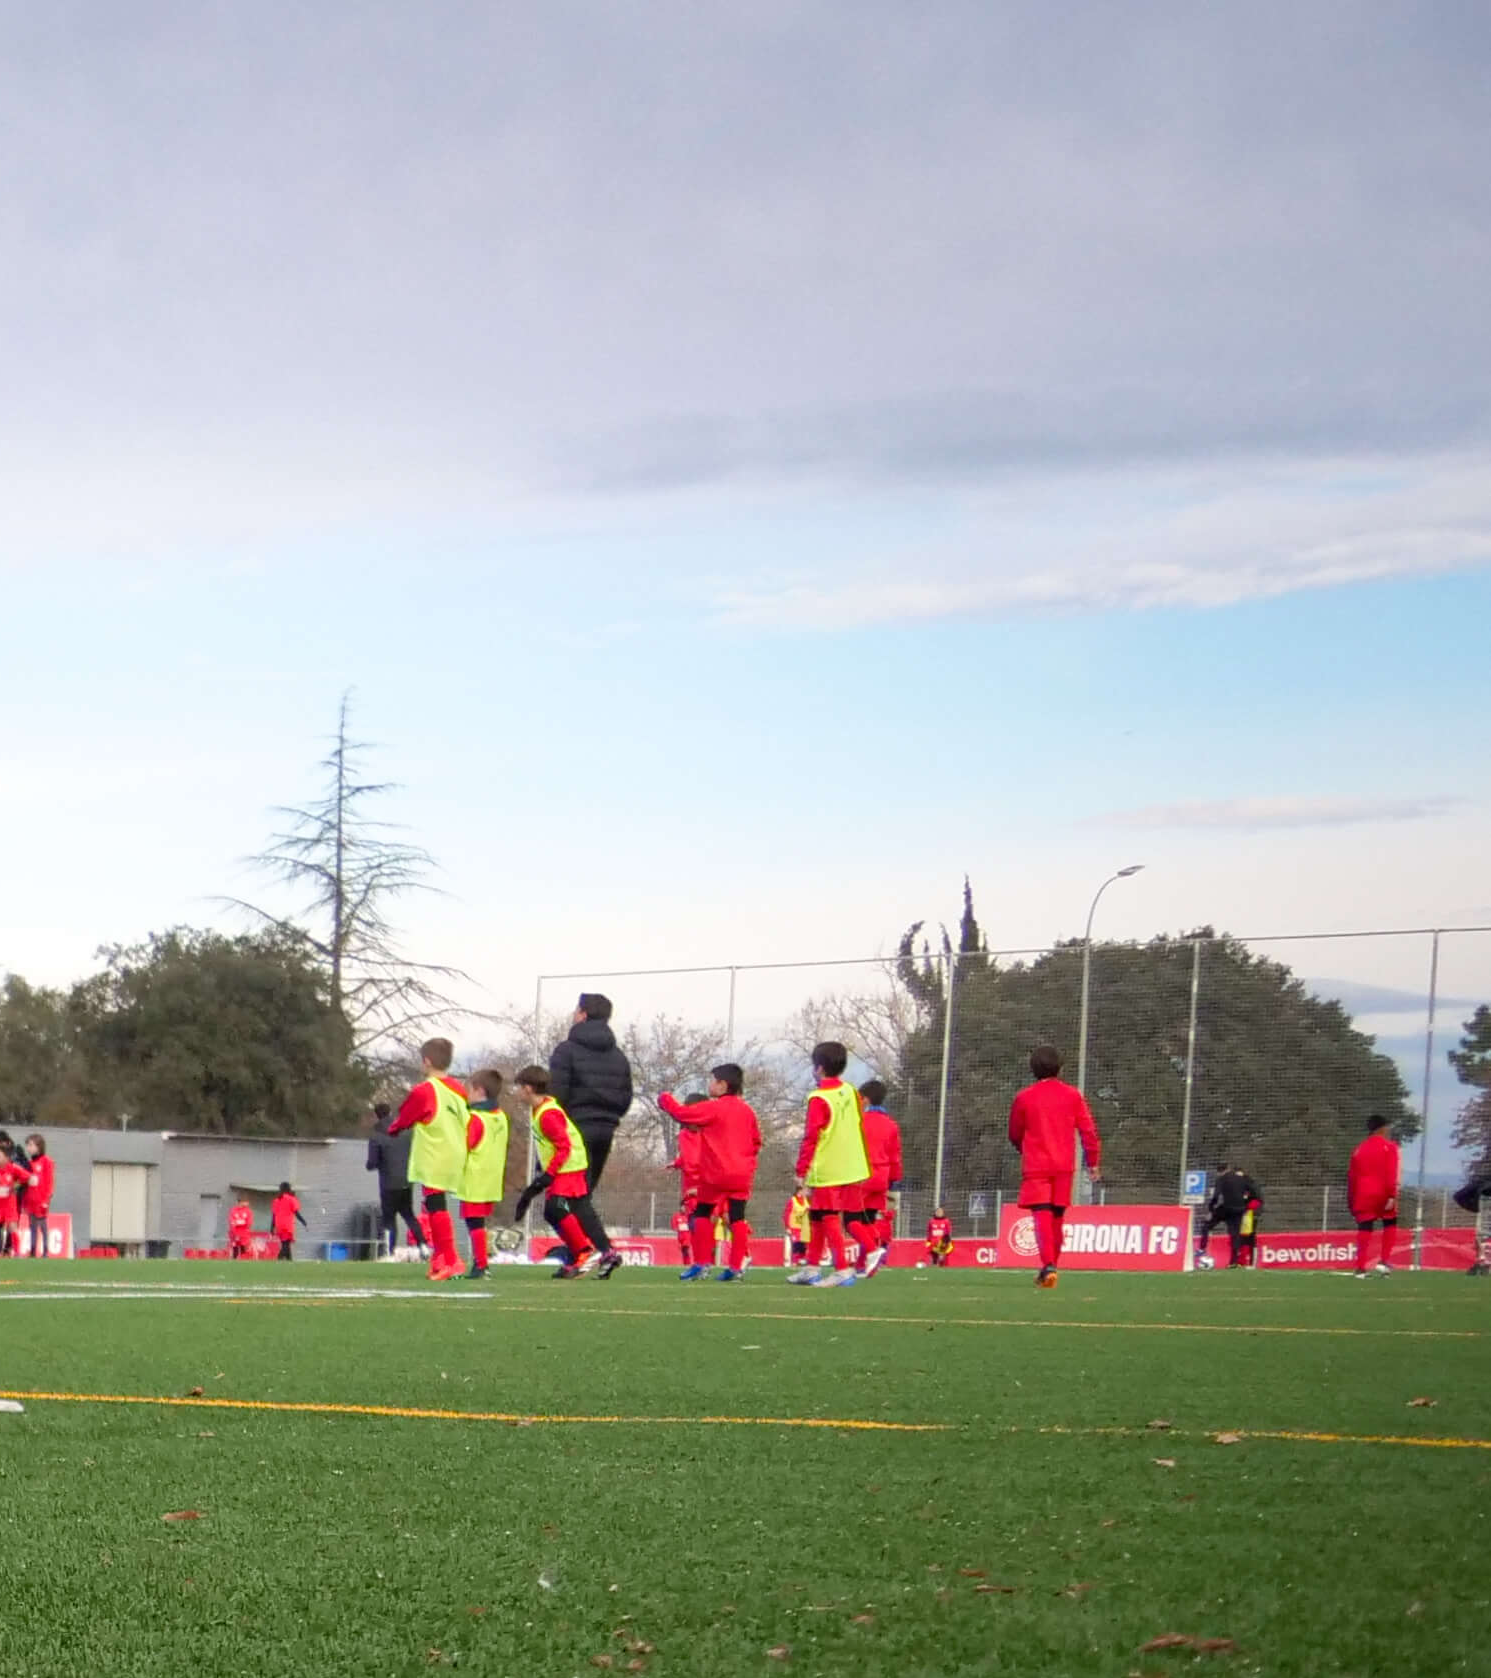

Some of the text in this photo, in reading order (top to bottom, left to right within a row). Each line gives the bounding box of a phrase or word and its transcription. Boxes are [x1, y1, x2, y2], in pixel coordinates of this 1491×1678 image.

[1186, 1174, 1201, 1193] P
[1061, 1224, 1143, 1254] GIRONA
[1148, 1225, 1179, 1255] FC
